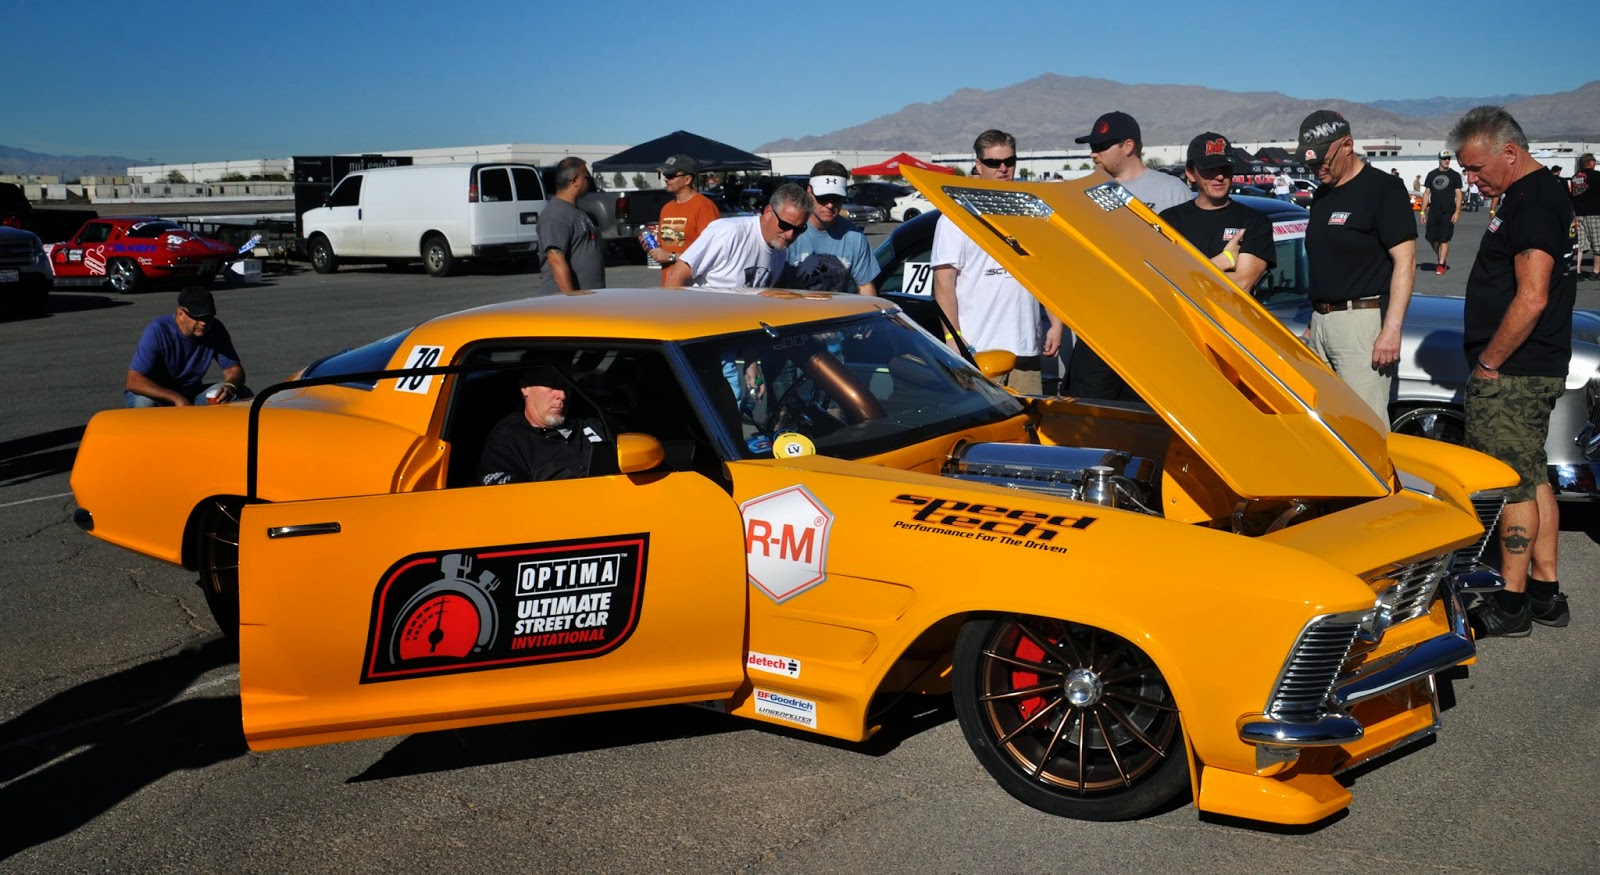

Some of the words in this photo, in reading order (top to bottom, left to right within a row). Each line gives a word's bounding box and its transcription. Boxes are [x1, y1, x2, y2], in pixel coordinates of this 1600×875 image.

[905, 264, 931, 294] 79
[397, 347, 441, 391] 78
[787, 446, 800, 454] LV
[891, 494, 1099, 530] speed
[912, 509, 1060, 542] tech
[893, 521, 974, 539] Performance
[975, 532, 998, 542] For
[1000, 536, 1022, 546] The
[1024, 540, 1068, 554] Driven
[521, 560, 615, 591] OPTIMA
[517, 592, 612, 619] ULTIMATE
[514, 614, 574, 636] STREET
[575, 611, 609, 628] CAR
[511, 628, 605, 651] INVITATIONAL
[757, 690, 813, 711] BFGoodrich
